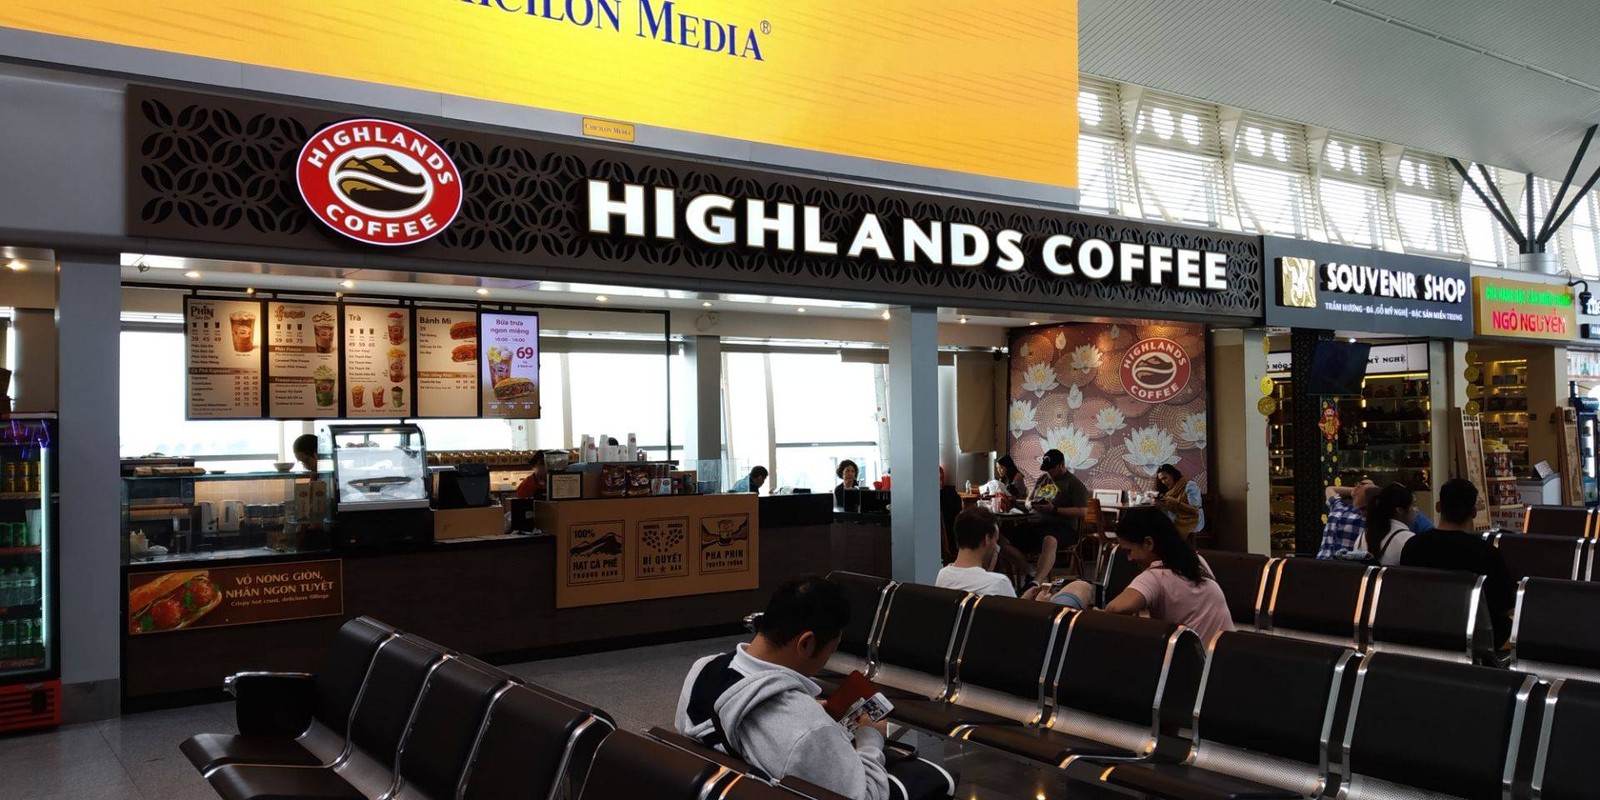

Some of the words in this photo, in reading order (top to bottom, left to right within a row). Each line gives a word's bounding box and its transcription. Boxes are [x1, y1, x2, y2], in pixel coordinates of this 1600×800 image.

[307, 126, 454, 185] HIGHLANDS
[326, 204, 437, 238] COFFEE
[588, 180, 1025, 272] HIGHLANDS
[1042, 234, 1228, 290] COFFEE
[1326, 262, 1418, 299] SOUVENIR
[1424, 273, 1467, 304] SHOP
[349, 313, 361, 321] Trà
[516, 346, 534, 360] 69
[1123, 341, 1187, 369] HIGHLANDS
[1131, 382, 1179, 399] COFFEE
[574, 529, 595, 539] 100%
[235, 573, 252, 586] VỎ
[256, 572, 289, 584] NÓNG
[263, 585, 297, 595] NGON
